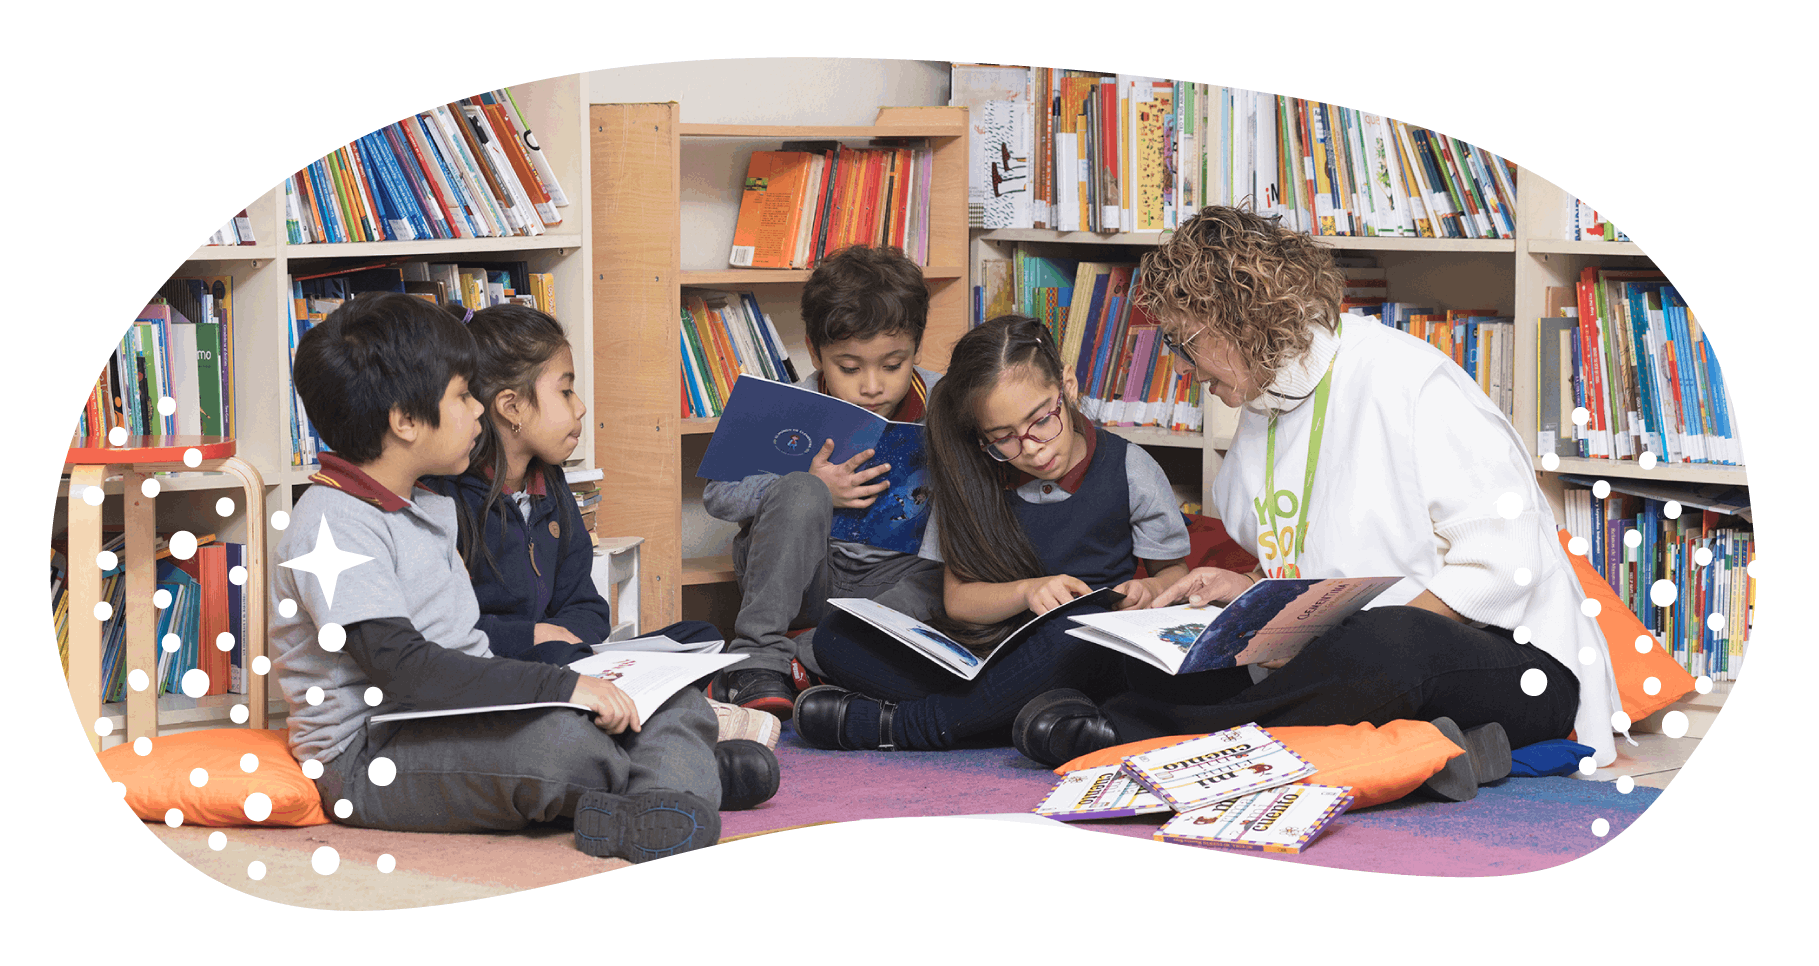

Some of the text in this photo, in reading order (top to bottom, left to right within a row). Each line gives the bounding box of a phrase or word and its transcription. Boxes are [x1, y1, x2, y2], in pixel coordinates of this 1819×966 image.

[1297, 583, 1350, 621] CLEMENTINA
[1163, 743, 1251, 771] cuento
[1194, 772, 1239, 789] mi
[1252, 793, 1300, 832] cuento
